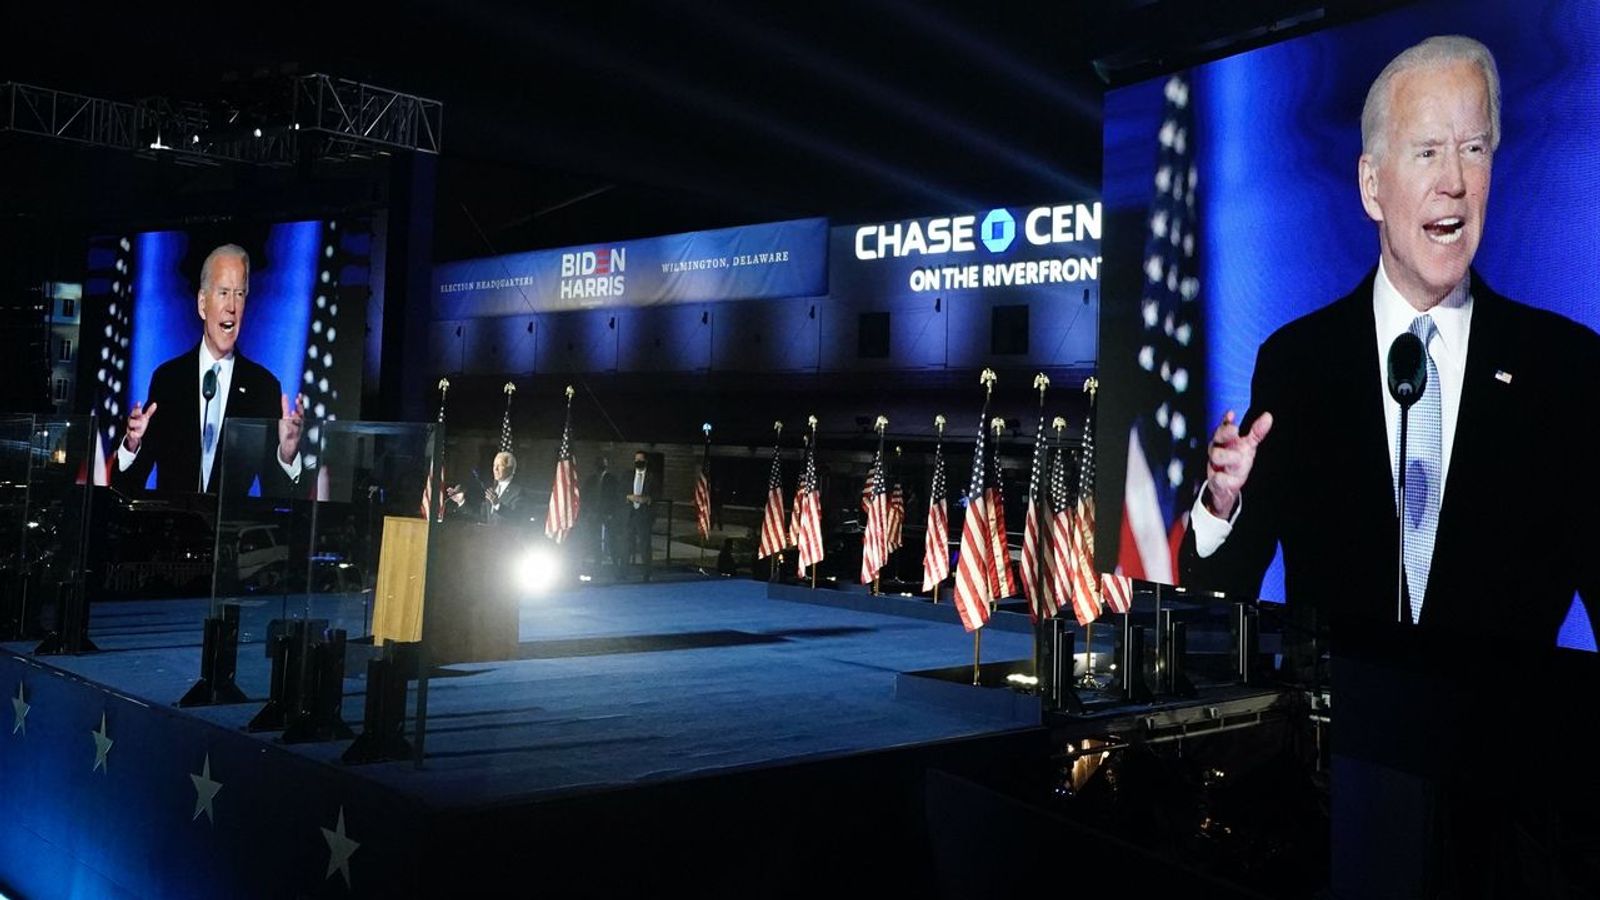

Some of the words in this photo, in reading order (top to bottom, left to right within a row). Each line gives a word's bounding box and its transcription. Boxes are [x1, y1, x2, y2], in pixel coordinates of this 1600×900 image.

[855, 215, 976, 260] CHASE
[1025, 202, 1102, 245] CEN
[561, 247, 626, 277] BIDEN
[661, 258, 730, 273] WILMINGTON,
[732, 251, 789, 267] DELAWARE
[909, 269, 940, 292] ON
[942, 265, 979, 289] THE
[982, 256, 1102, 287] RIVERFRON
[440, 281, 474, 293] ELECTION
[475, 276, 534, 290] HEADQUARTERS
[560, 275, 625, 299] HARRIS
